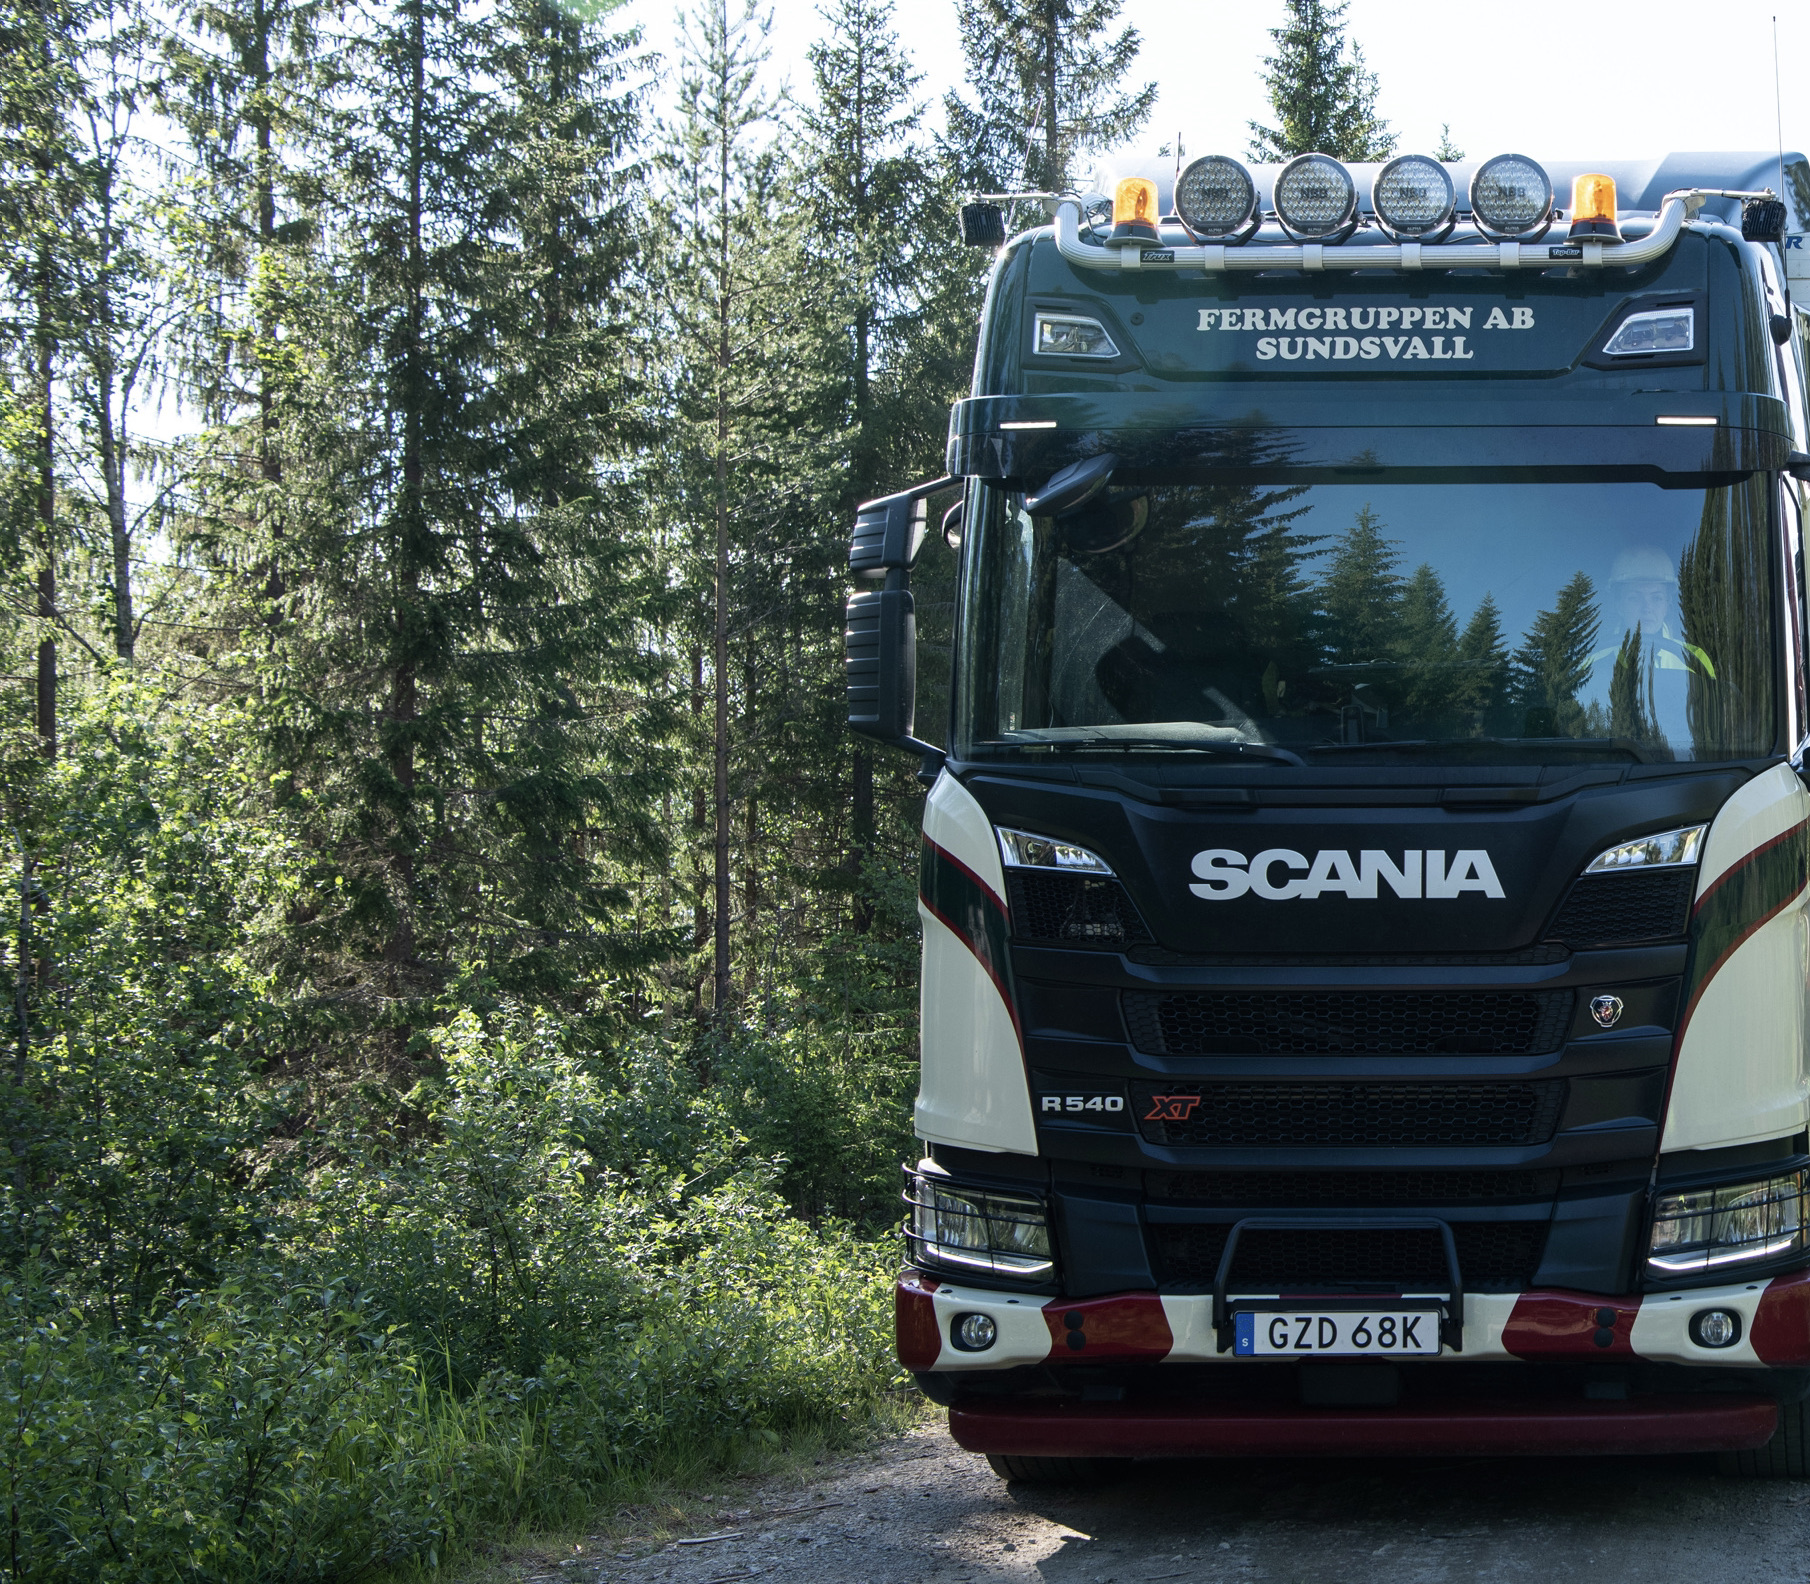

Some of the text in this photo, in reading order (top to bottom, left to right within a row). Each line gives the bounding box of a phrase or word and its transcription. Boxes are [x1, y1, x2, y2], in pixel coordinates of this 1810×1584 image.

[1196, 307, 1535, 331] FERMGRUPPEN AB
[1255, 336, 1474, 360] SUNDSVALL
[1188, 848, 1506, 900] SCANIA
[1041, 1096, 1124, 1112] R 540
[1144, 1095, 1201, 1120] XT
[1241, 1337, 1249, 1347] S
[1268, 1316, 1422, 1349] GZD 68K
